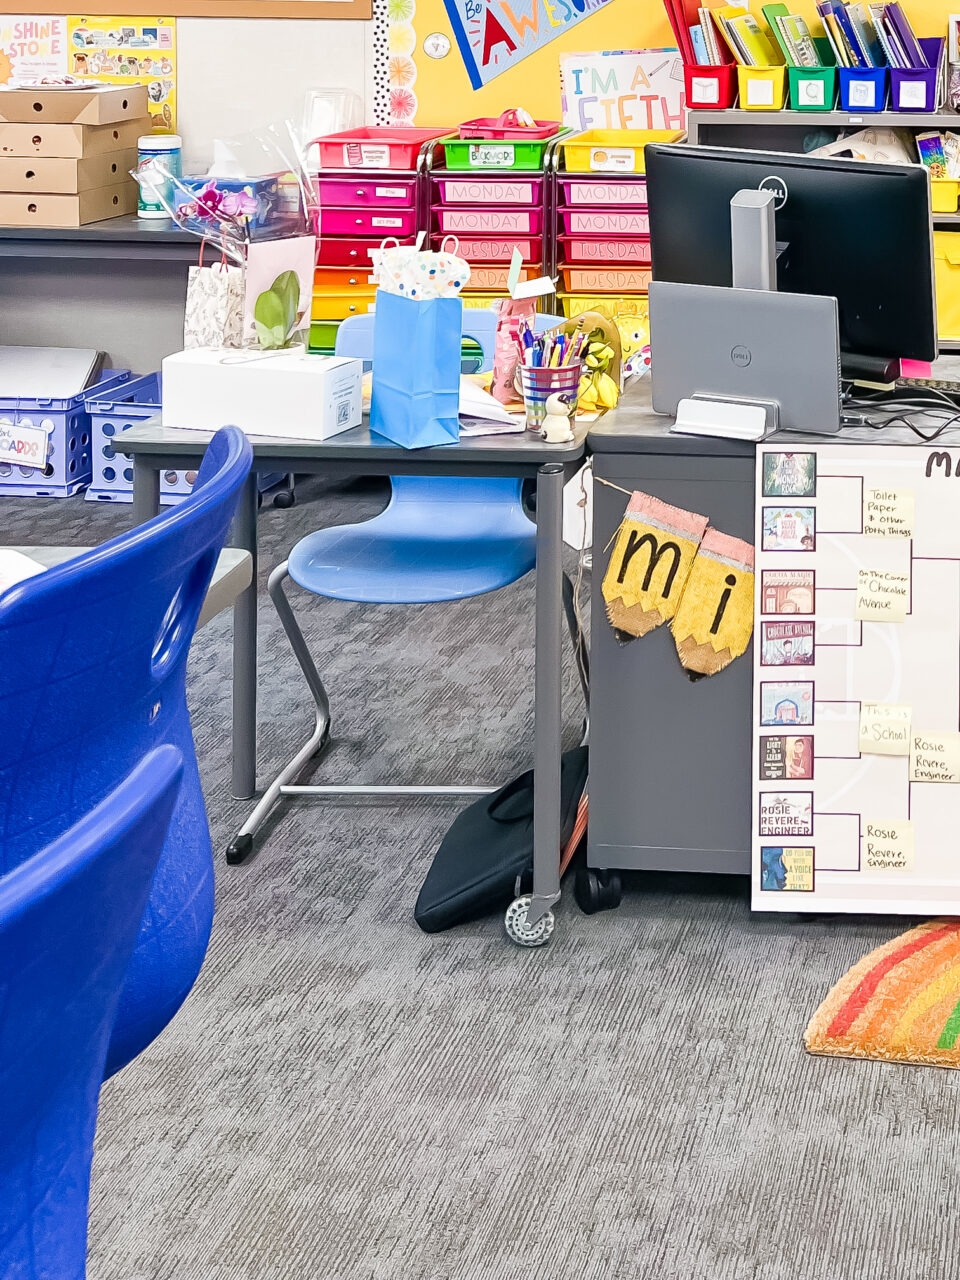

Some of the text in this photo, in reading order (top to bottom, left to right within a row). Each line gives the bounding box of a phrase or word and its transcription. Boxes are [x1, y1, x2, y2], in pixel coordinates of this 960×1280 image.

[465, 0, 482, 20] Be
[571, 65, 652, 95] I'M A
[452, 185, 524, 200] MONDAY
[577, 185, 647, 201] MONDAY
[450, 214, 521, 230] MONDAY
[577, 215, 649, 230] MONDAY
[579, 241, 649, 258] TUESDAY
[578, 272, 648, 288] TUESDAY
[870, 489, 898, 501] Toilet
[867, 502, 897, 515] Paper
[879, 514, 906, 524] Other
[887, 527, 912, 538] Things
[871, 723, 908, 742] School
[914, 738, 945, 753] Rosie
[914, 769, 955, 781] Engineer
[762, 805, 790, 815] ROSIE
[761, 826, 810, 835] ENGINEER
[867, 825, 898, 840] Rosie
[867, 858, 907, 870] Engineer
